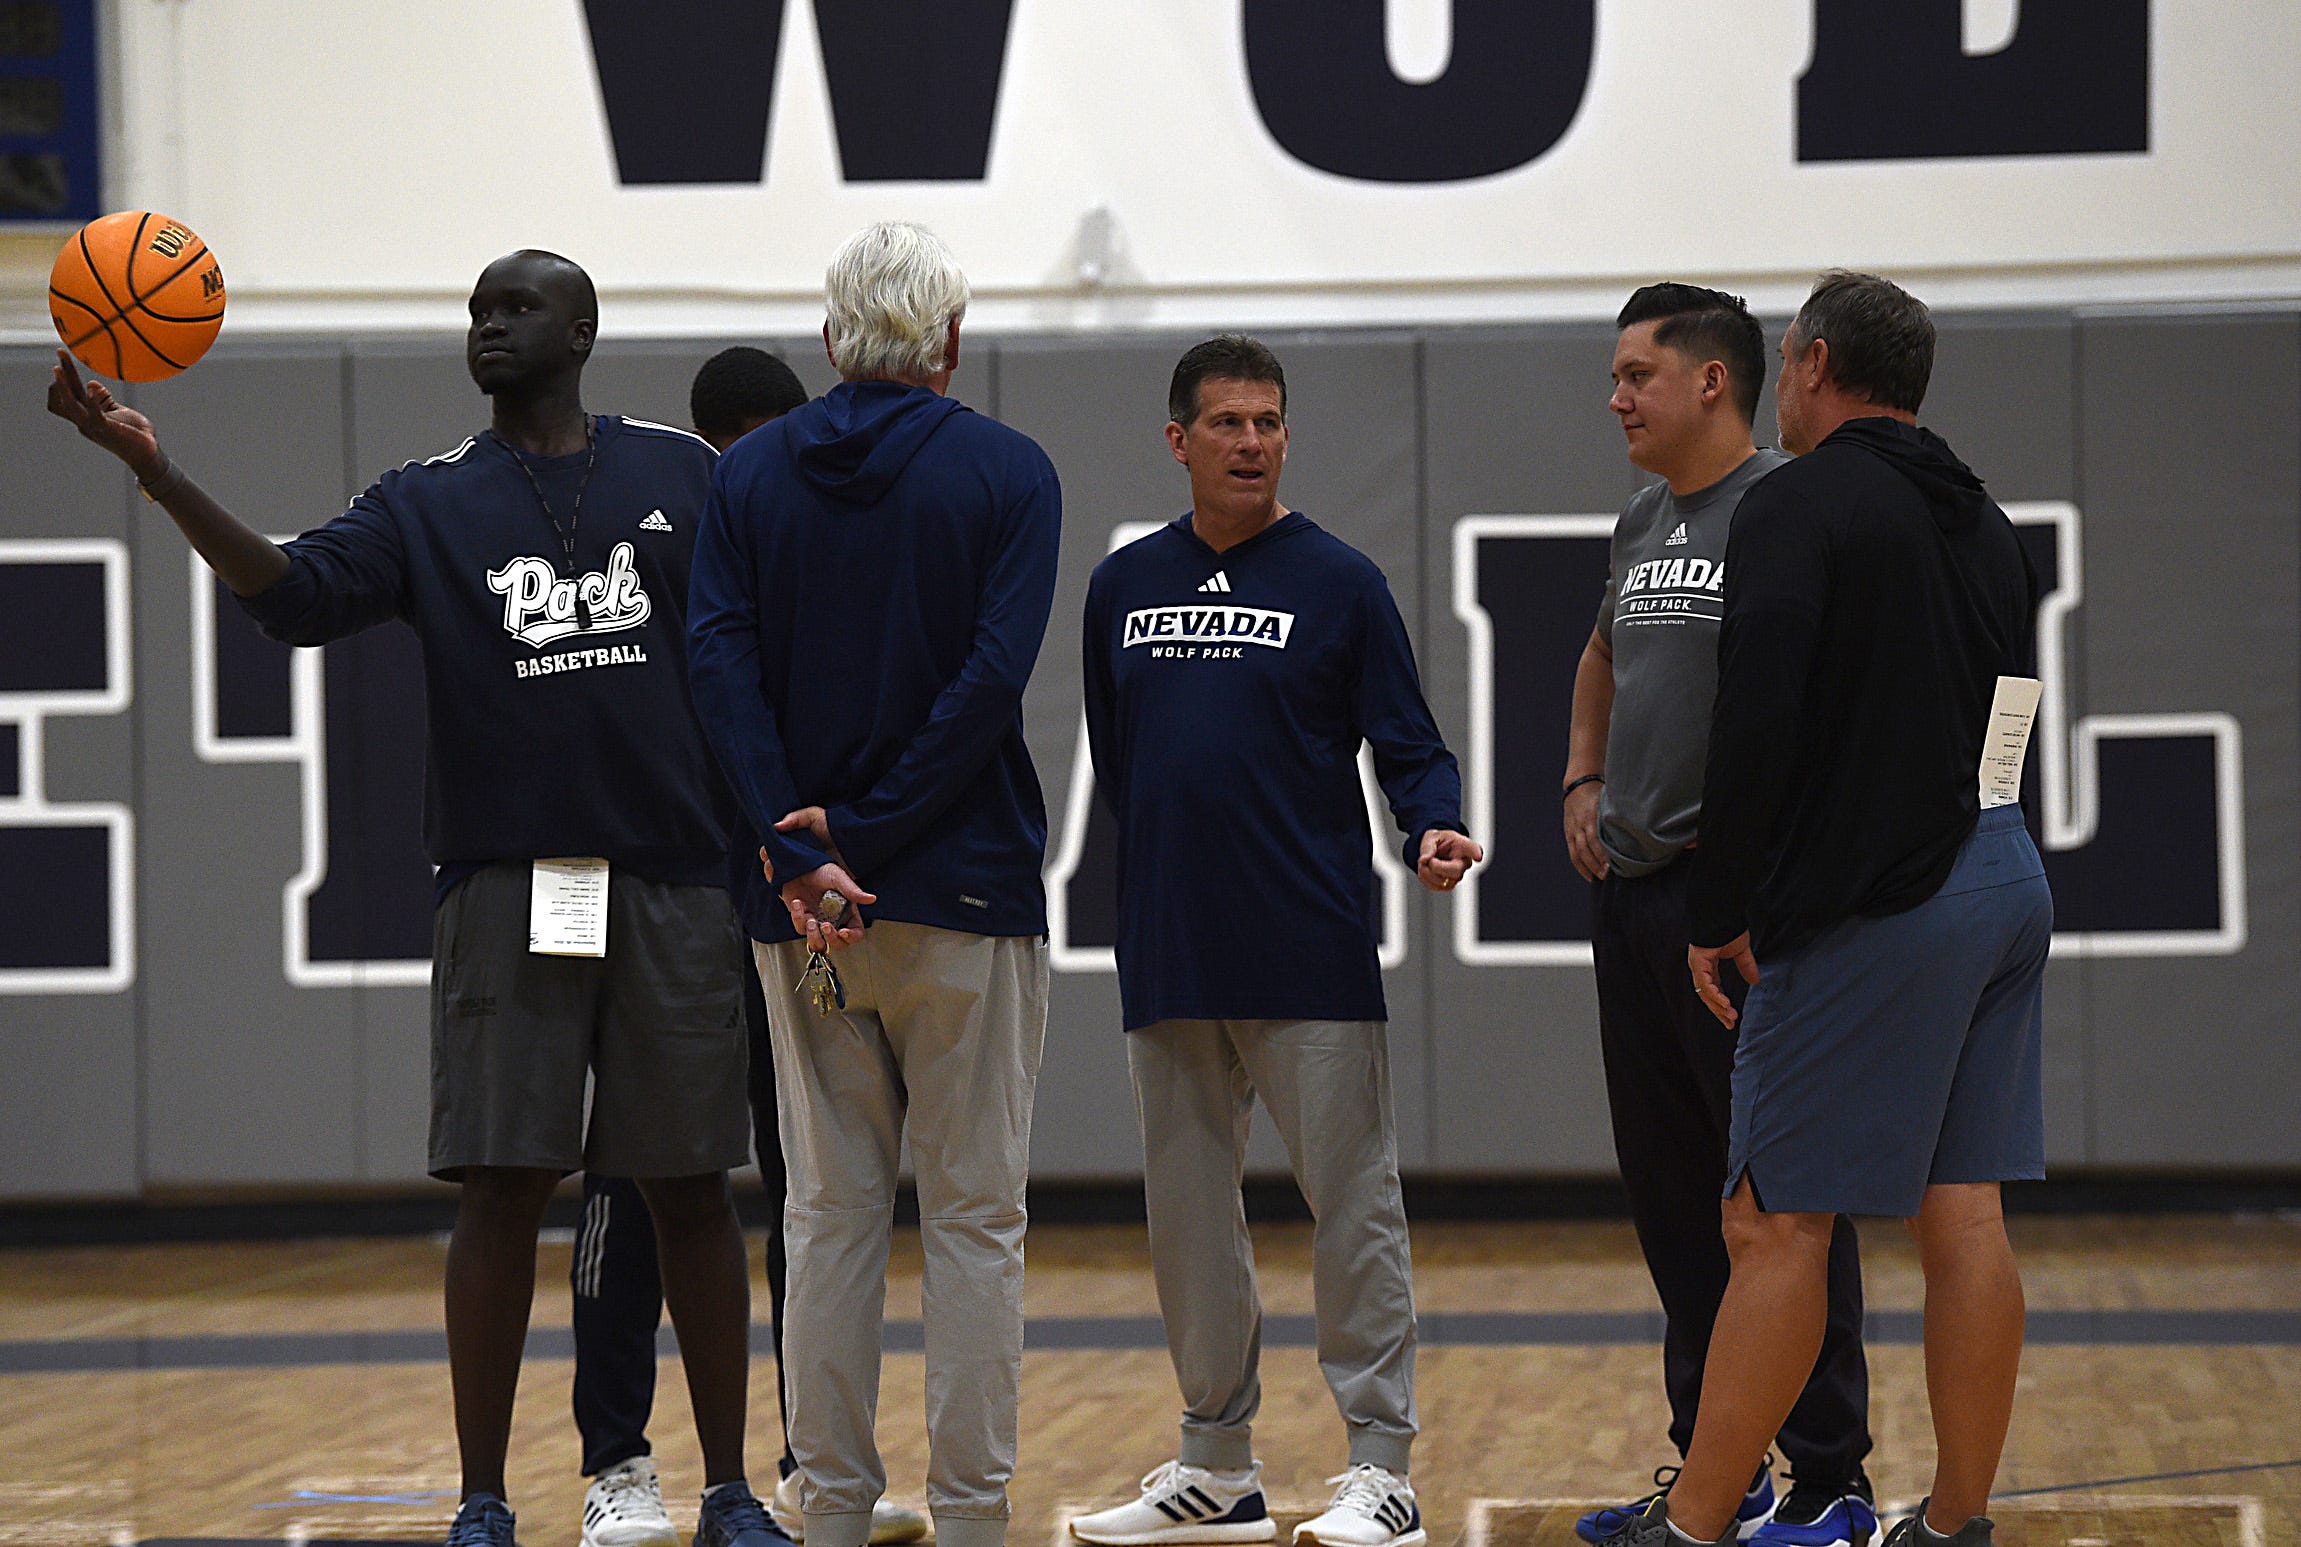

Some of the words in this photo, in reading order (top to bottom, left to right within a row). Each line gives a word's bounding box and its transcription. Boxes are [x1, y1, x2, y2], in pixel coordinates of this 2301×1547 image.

[639, 521, 673, 532] adidas
[1665, 537, 1688, 546] adidas
[1620, 558, 1724, 597] NEVADA
[487, 542, 651, 649] Pack
[1629, 600, 1657, 612] WOLF
[1660, 599, 1691, 611] PACK
[1128, 611, 1282, 642] NEVADA
[515, 645, 647, 679] BASKETBALL
[1151, 646, 1196, 659] WOLF
[1202, 646, 1243, 659] PACK
